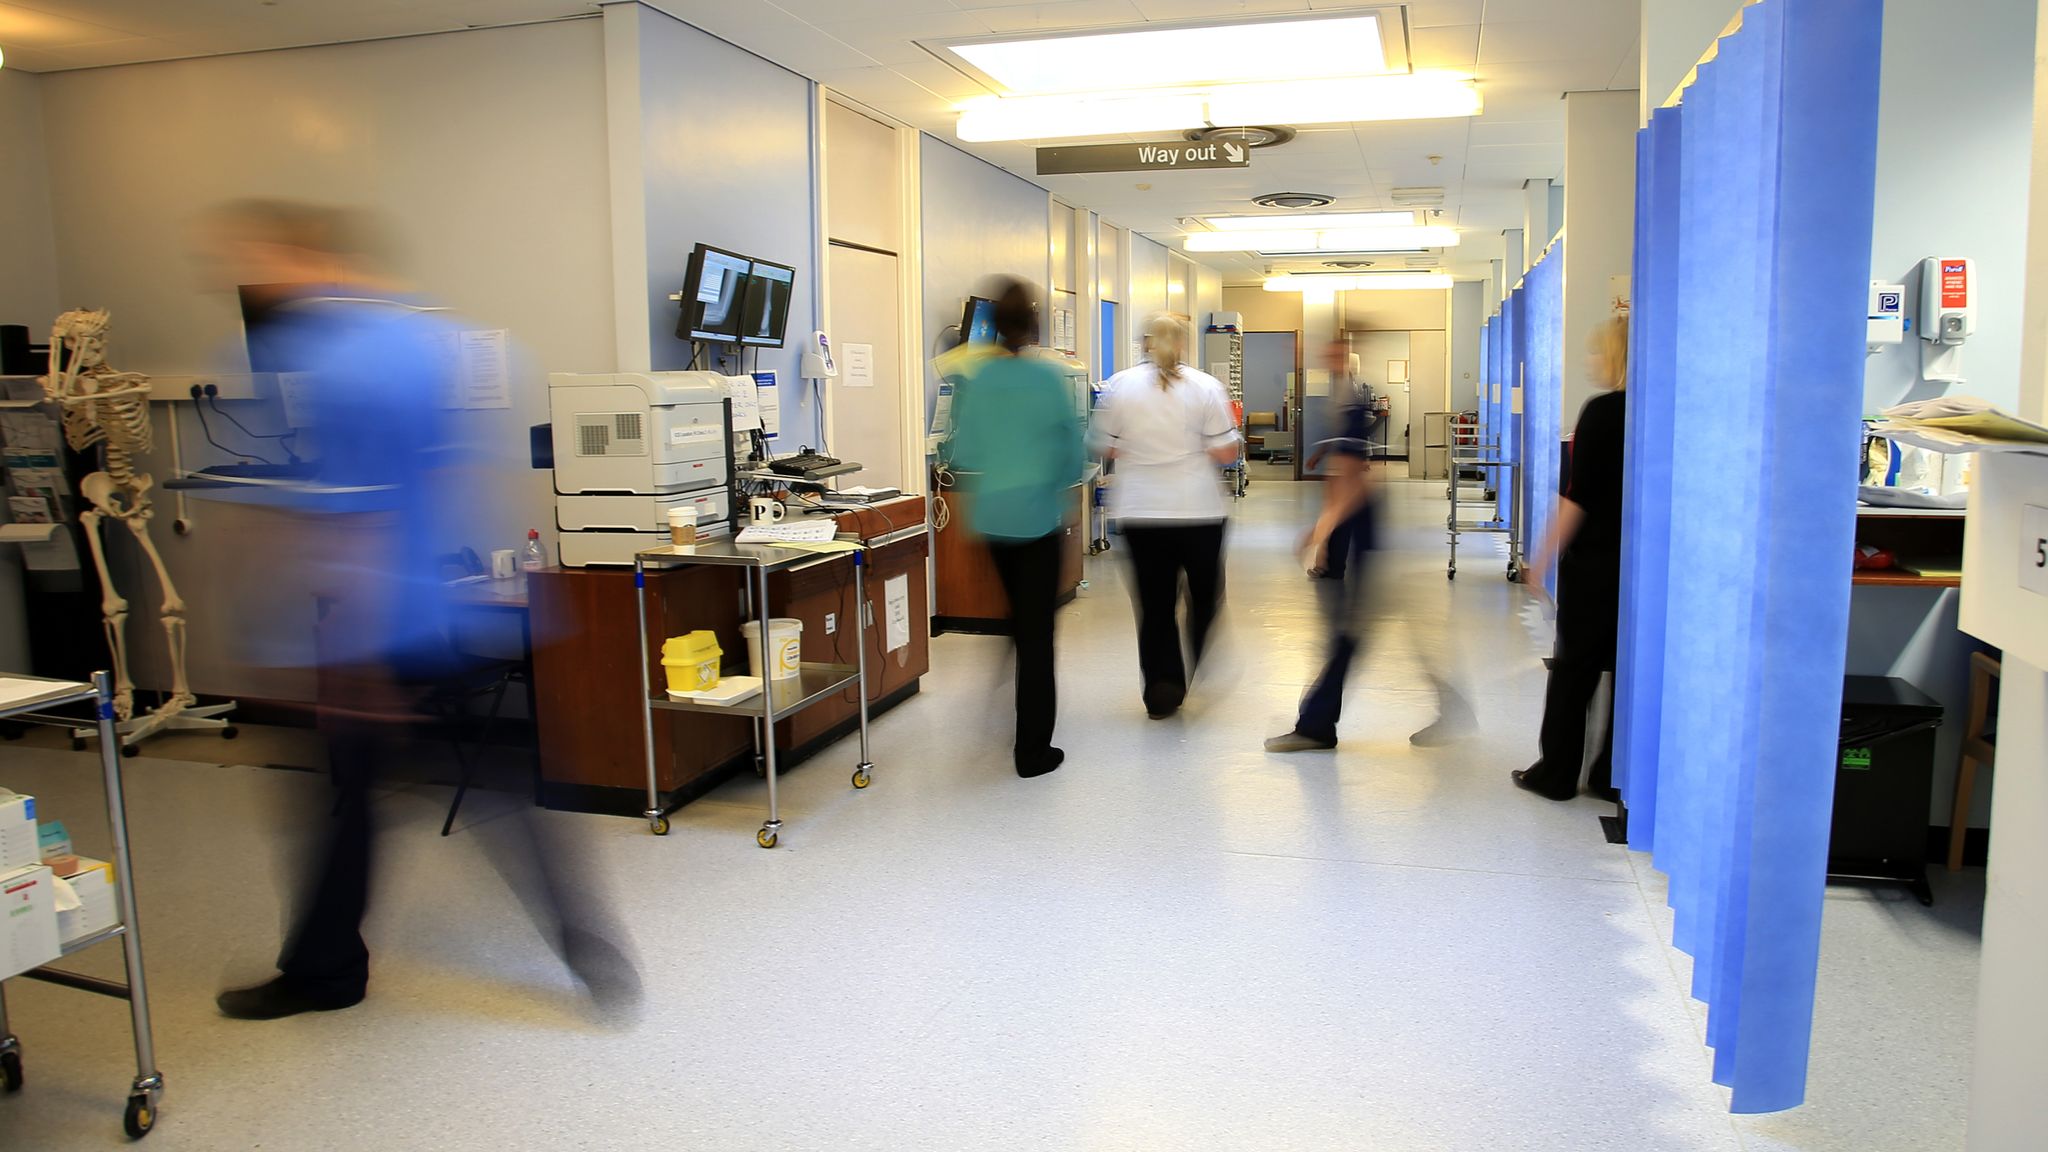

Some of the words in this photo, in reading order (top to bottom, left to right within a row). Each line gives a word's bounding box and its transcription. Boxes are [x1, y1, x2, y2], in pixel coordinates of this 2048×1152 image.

[1138, 146, 1180, 165] Way
[1185, 144, 1217, 162] out
[754, 505, 766, 520] P
[2036, 538, 2047, 568] 5
